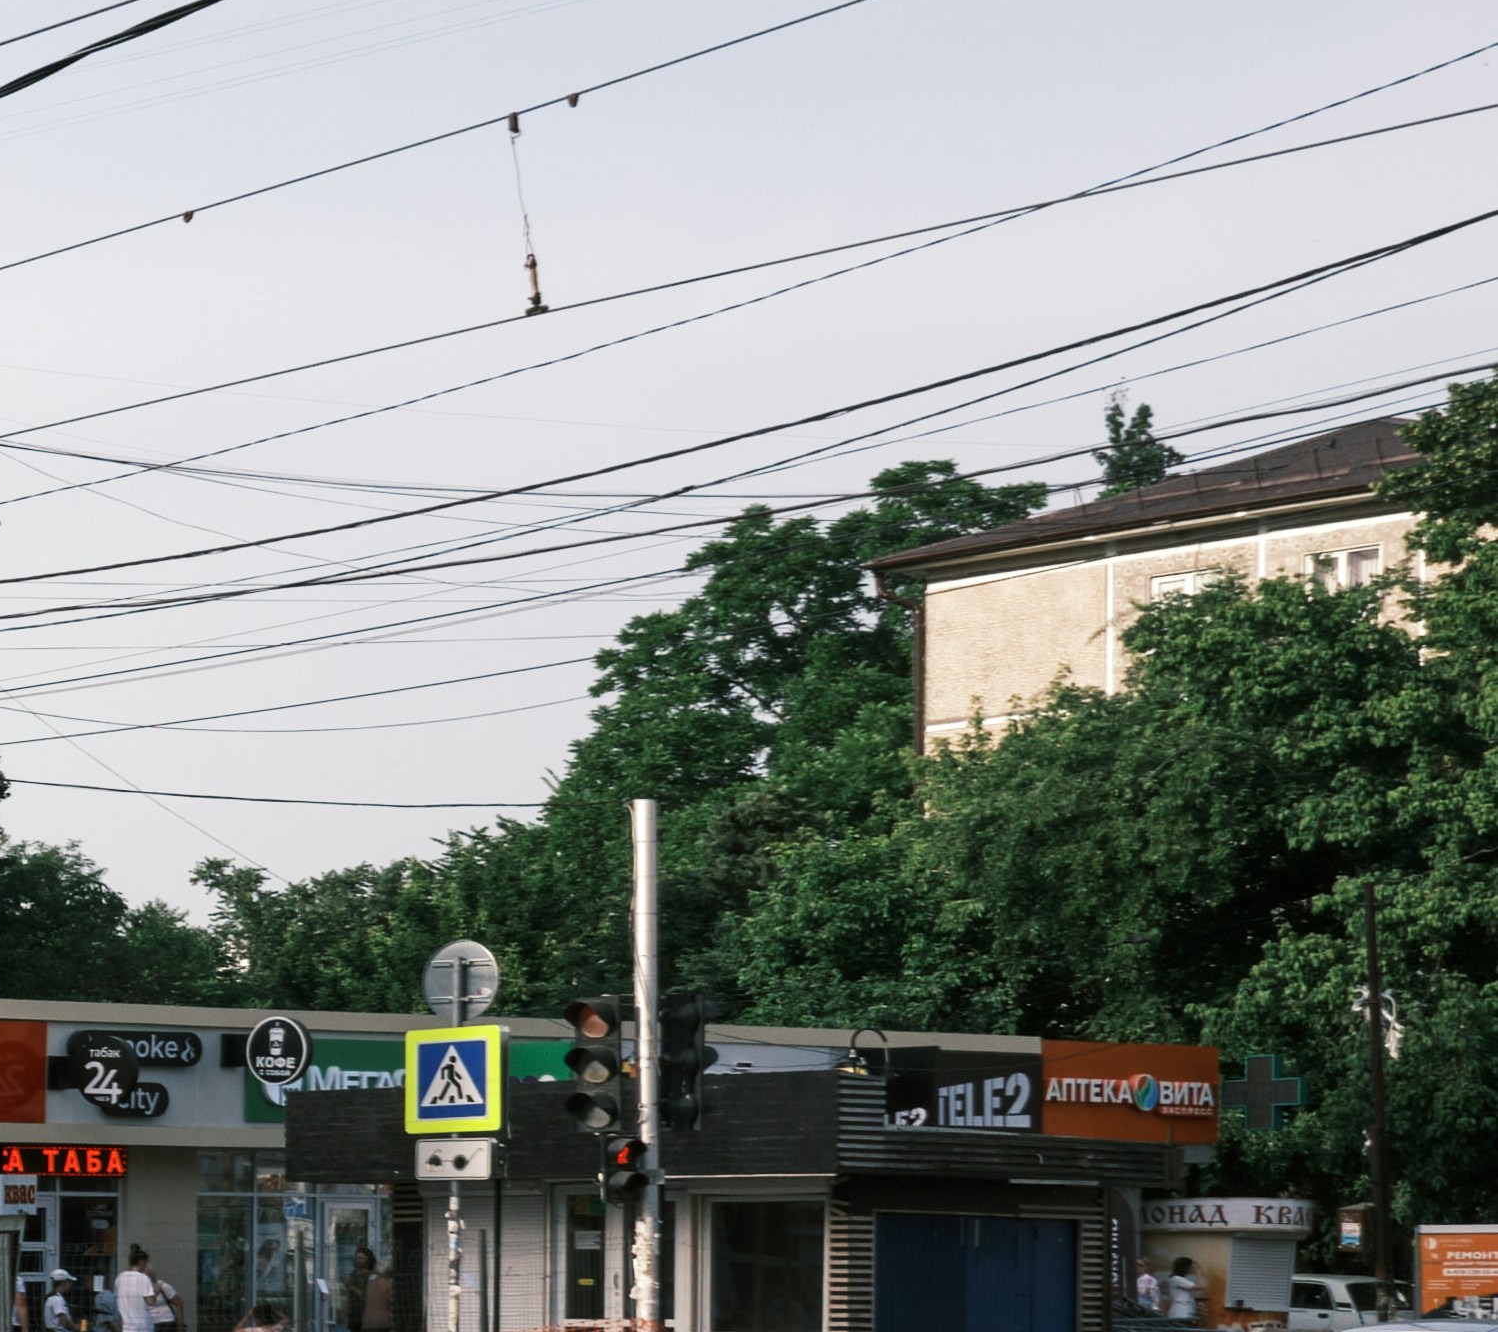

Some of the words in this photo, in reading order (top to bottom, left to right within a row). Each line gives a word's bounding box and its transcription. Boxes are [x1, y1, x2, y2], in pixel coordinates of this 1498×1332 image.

[89, 1047, 121, 1058] табак
[125, 1034, 179, 1059] oke
[255, 1056, 296, 1069] КОФЕ
[84, 1061, 123, 1105] 24
[307, 1065, 406, 1091] МЕГА
[1045, 1076, 1134, 1104] АПТЕКА
[1159, 1080, 1215, 1106] ВИТА
[938, 1072, 1031, 1129] TELE2
[42, 1148, 127, 1174] ТАБА
[1252, 1204, 1308, 1225] КВА
